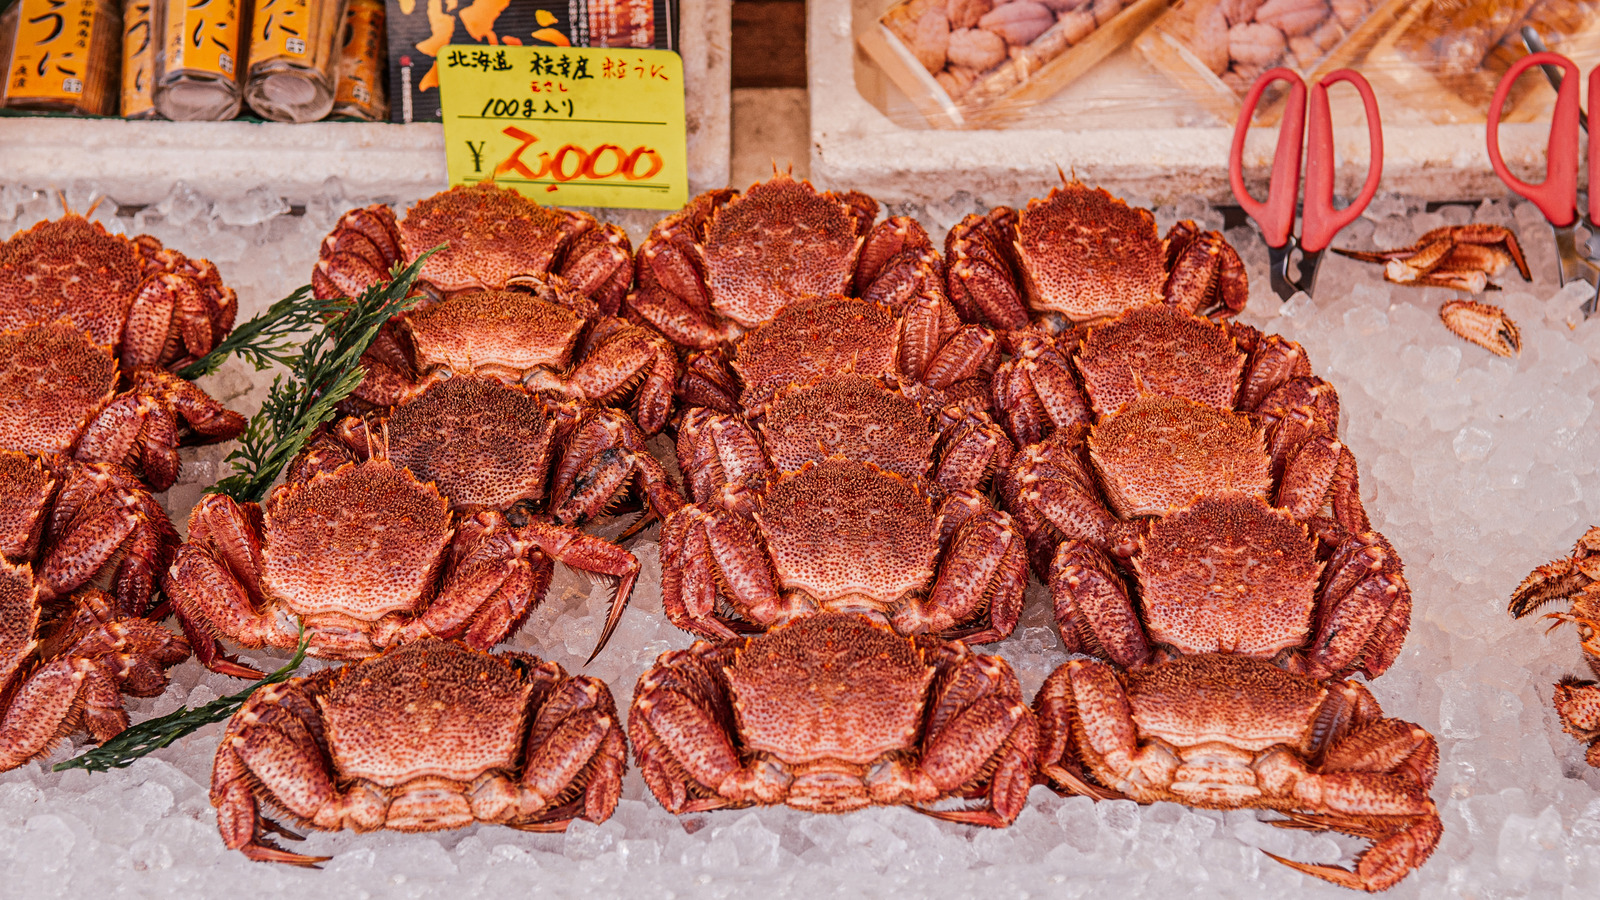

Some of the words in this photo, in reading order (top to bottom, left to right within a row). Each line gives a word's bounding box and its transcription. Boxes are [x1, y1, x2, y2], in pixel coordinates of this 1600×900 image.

[28, 0, 77, 77] うに
[447, 50, 513, 72] 北海道
[530, 52, 594, 80] 枝幸産
[602, 57, 669, 81] 粒うに
